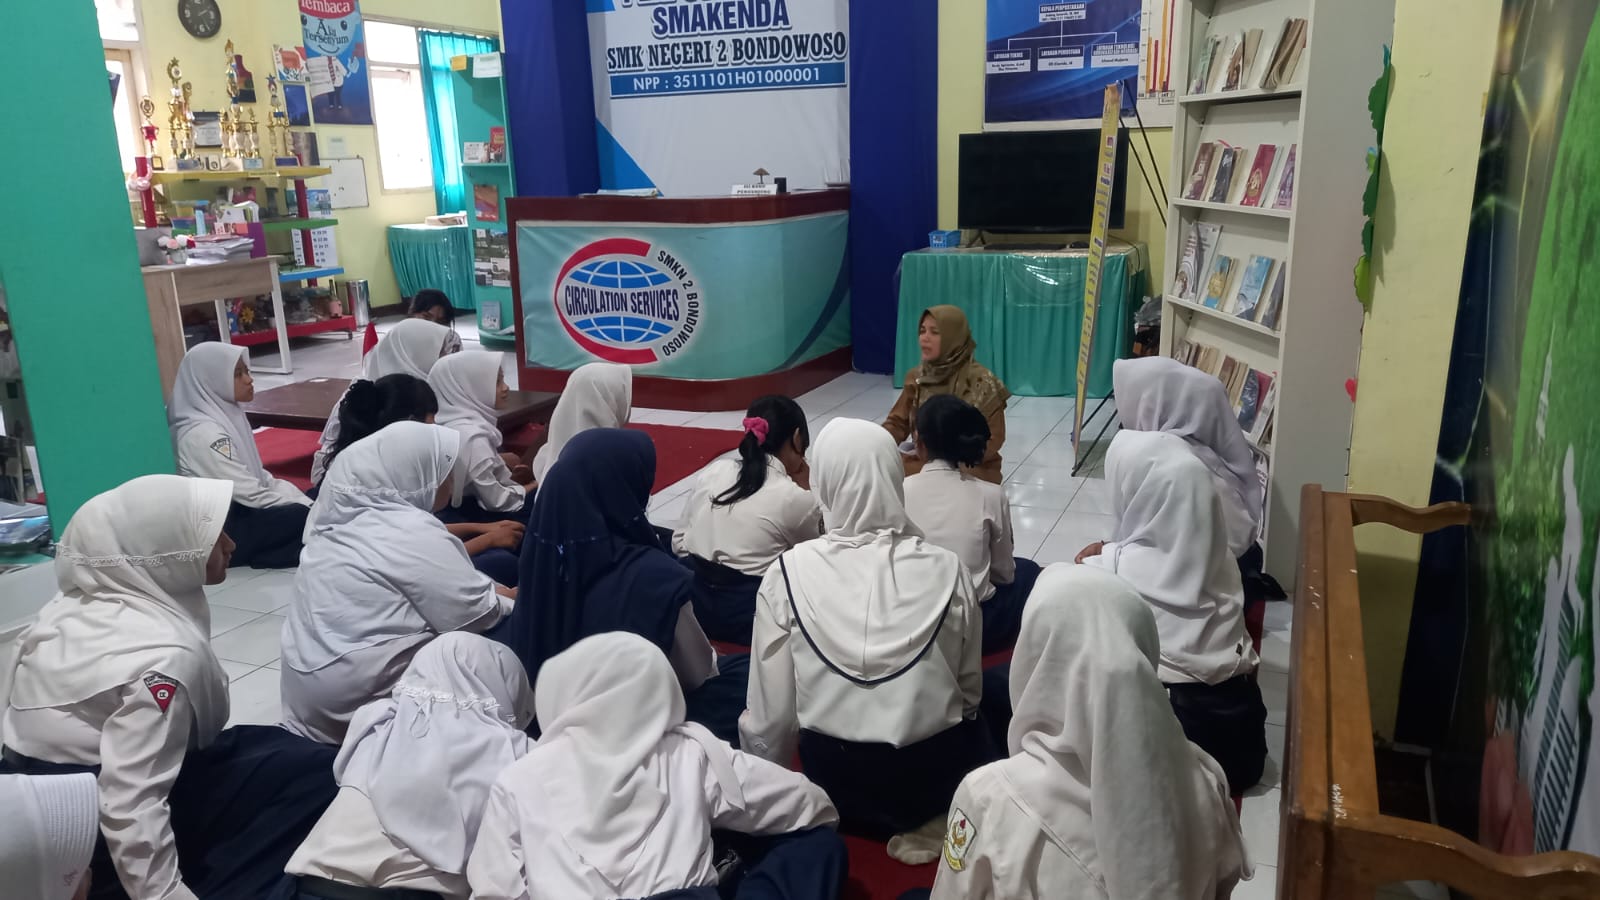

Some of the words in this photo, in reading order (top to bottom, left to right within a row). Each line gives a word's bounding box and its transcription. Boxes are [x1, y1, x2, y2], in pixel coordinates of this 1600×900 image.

[316, 18, 337, 36] Ala
[653, 0, 790, 34] SMAKENDA
[607, 45, 643, 69] SMK
[648, 40, 713, 67] NEGERI
[717, 39, 727, 62] 2
[732, 31, 846, 60] BONDOWOSO
[633, 76, 660, 91] NPP
[673, 67, 819, 88] 3511101H01000001
[658, 250, 687, 280] SMKN
[683, 280, 693, 290] 2
[565, 285, 628, 316] CIRCULATION
[630, 288, 680, 322] SERVICES
[662, 292, 699, 357] BONDOWOSO
